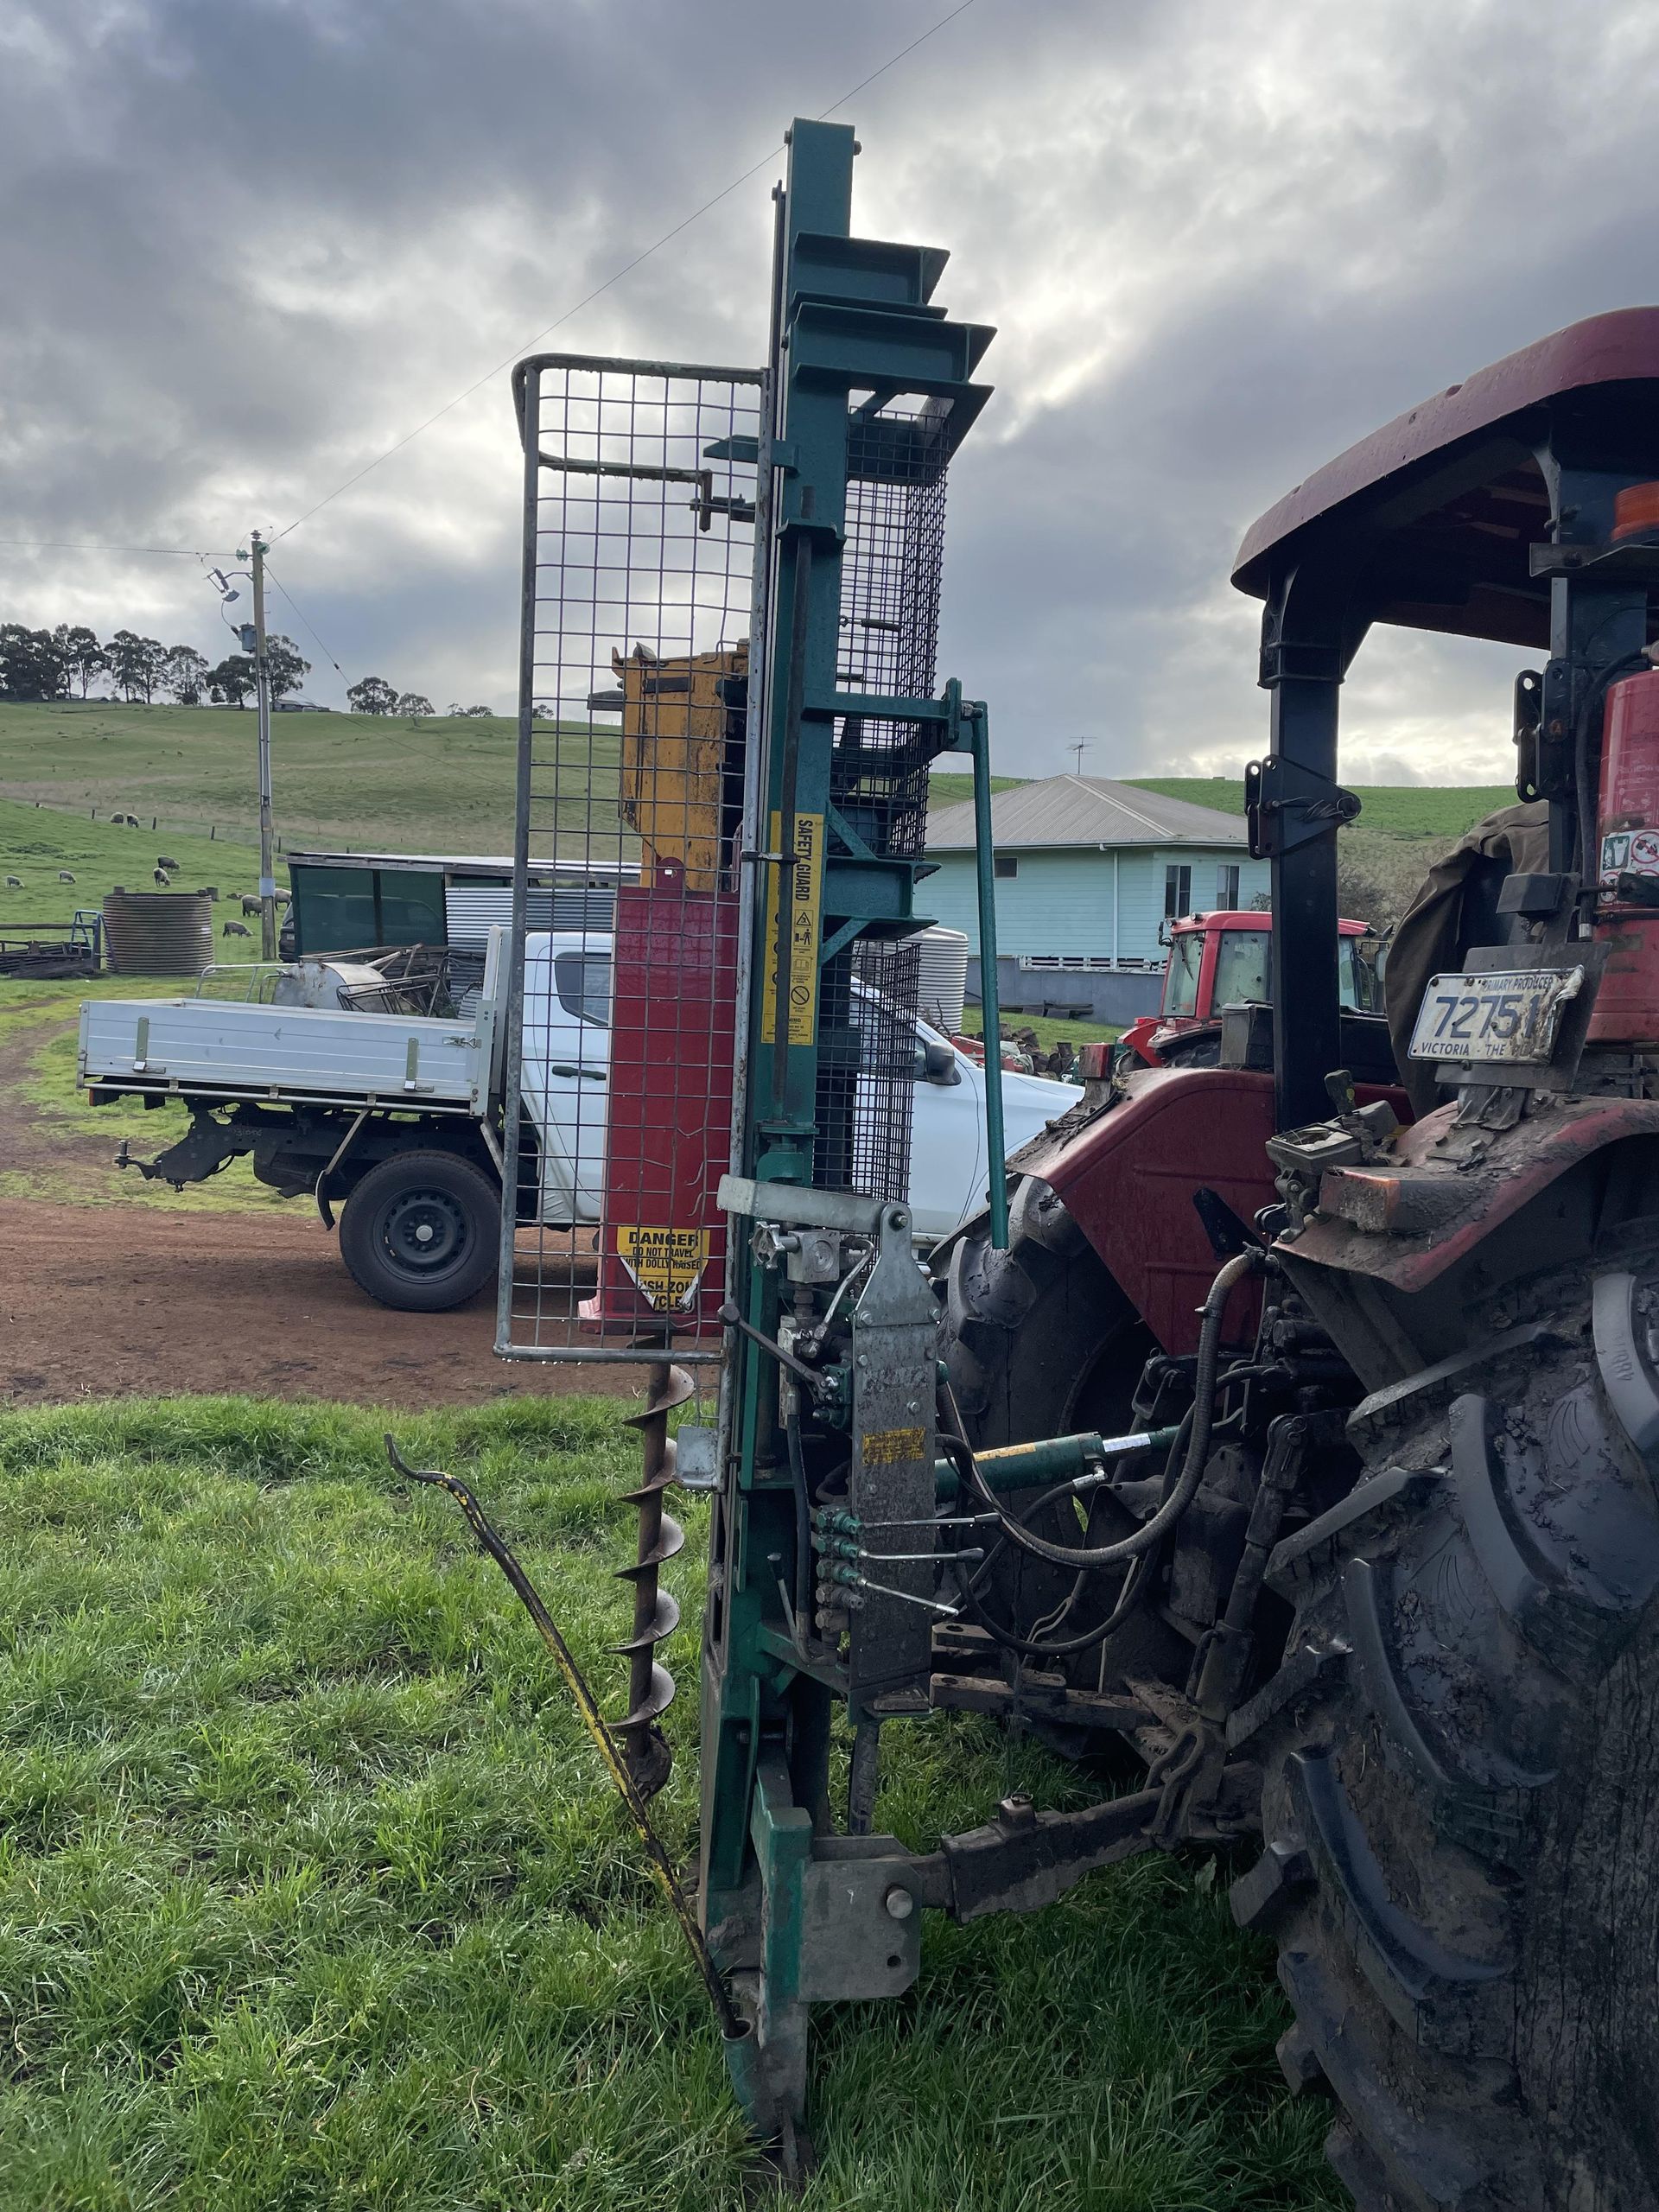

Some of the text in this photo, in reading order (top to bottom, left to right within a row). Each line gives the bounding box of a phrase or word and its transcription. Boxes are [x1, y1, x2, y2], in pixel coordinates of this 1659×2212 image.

[795, 819, 813, 901] SAFETY GUARD
[1484, 976, 1554, 991] PRIMARY PRODUCER
[1434, 995, 1541, 1039] 72751
[1421, 1041, 1469, 1056] VICTORIA
[1484, 1043, 1507, 1056] THE
[629, 1231, 699, 1247] DANGER
[632, 1246, 694, 1258] DO NOT TRAVEL
[645, 1258, 670, 1269] DOLLY
